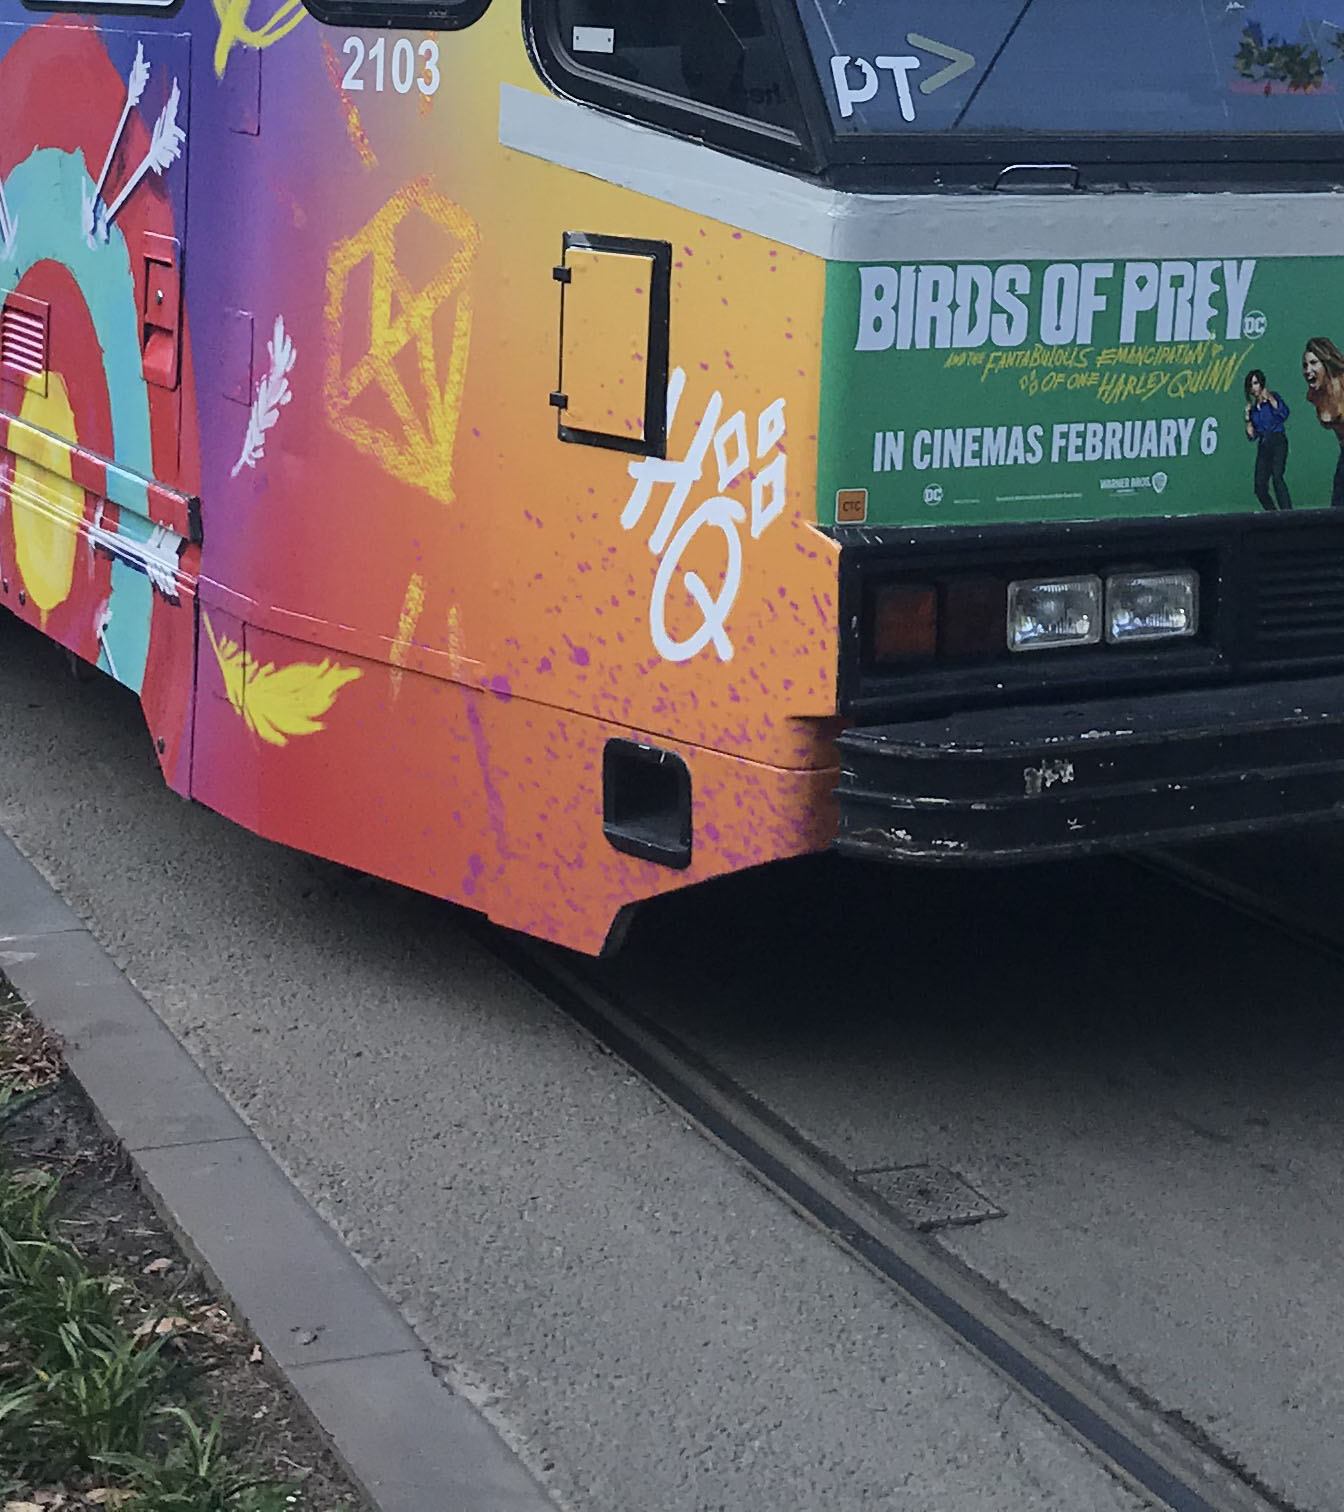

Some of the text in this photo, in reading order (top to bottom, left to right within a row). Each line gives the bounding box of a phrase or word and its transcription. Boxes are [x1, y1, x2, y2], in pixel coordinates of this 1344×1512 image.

[341, 36, 440, 95] 2103
[854, 259, 1256, 351] BIRDS OF PREY
[1096, 371, 1170, 404] HARLEY
[1167, 343, 1254, 398] QUINN
[872, 416, 1218, 472] IN CINEMAS FEBRUARY 6
[842, 500, 862, 512] CTC
[924, 487, 943, 502] DC
